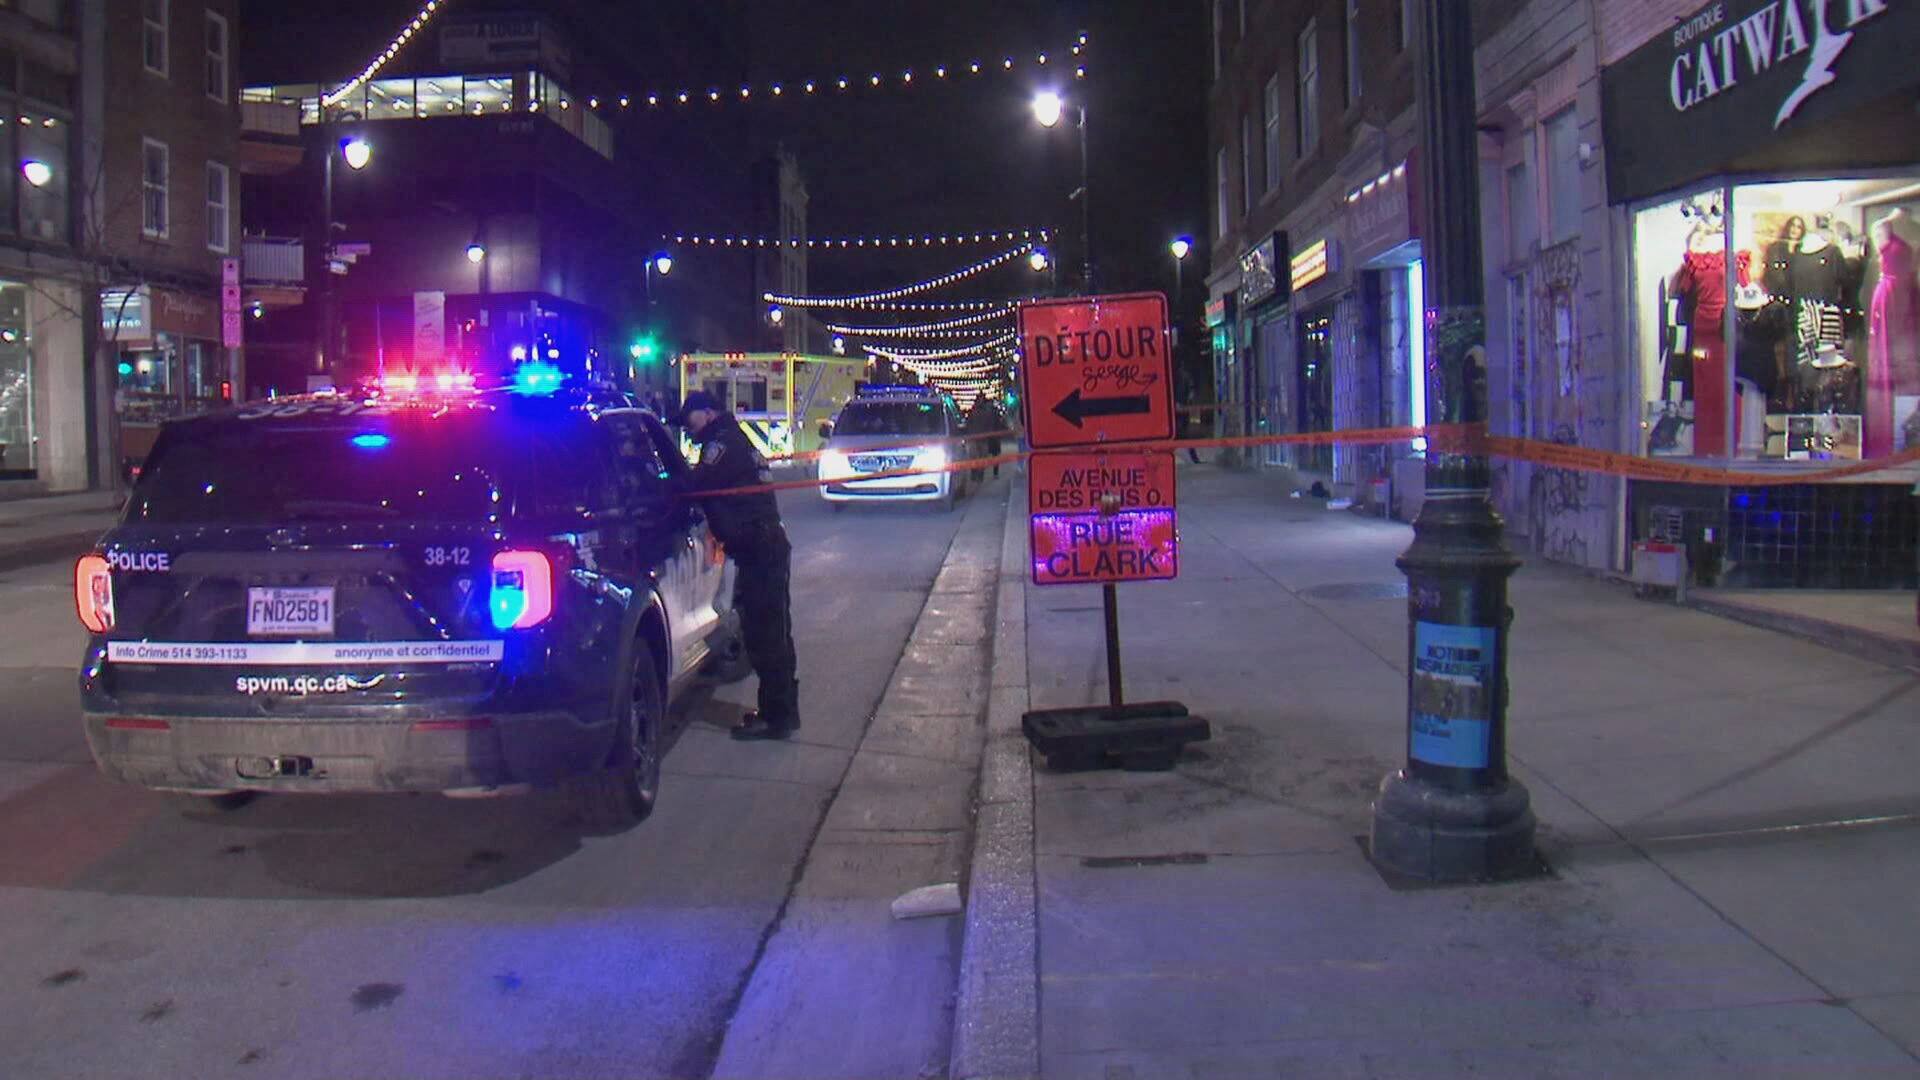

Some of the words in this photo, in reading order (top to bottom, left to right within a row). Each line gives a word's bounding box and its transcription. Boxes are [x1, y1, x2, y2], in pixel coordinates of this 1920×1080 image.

[1674, 3, 1725, 47] BOUTIQUE
[1035, 326, 1156, 368] DÉTOUR
[1060, 468, 1146, 488] AVENUE
[1039, 490, 1083, 508] DES
[1090, 488, 1140, 507] PS
[1070, 520, 1134, 548] RUE
[107, 551, 170, 570] POLICE
[424, 547, 470, 566] 38-12
[1047, 549, 1159, 578] CLARK
[252, 599, 329, 623] FND2581
[116, 646, 135, 658] Info
[137, 646, 169, 658] Crime
[171, 647, 191, 659] 514
[194, 647, 248, 660] 393-1133
[335, 648, 395, 661] anonyme
[397, 646, 410, 657] et
[412, 645, 490, 658] confidentiel
[236, 674, 349, 695] spvm.qc.ca
